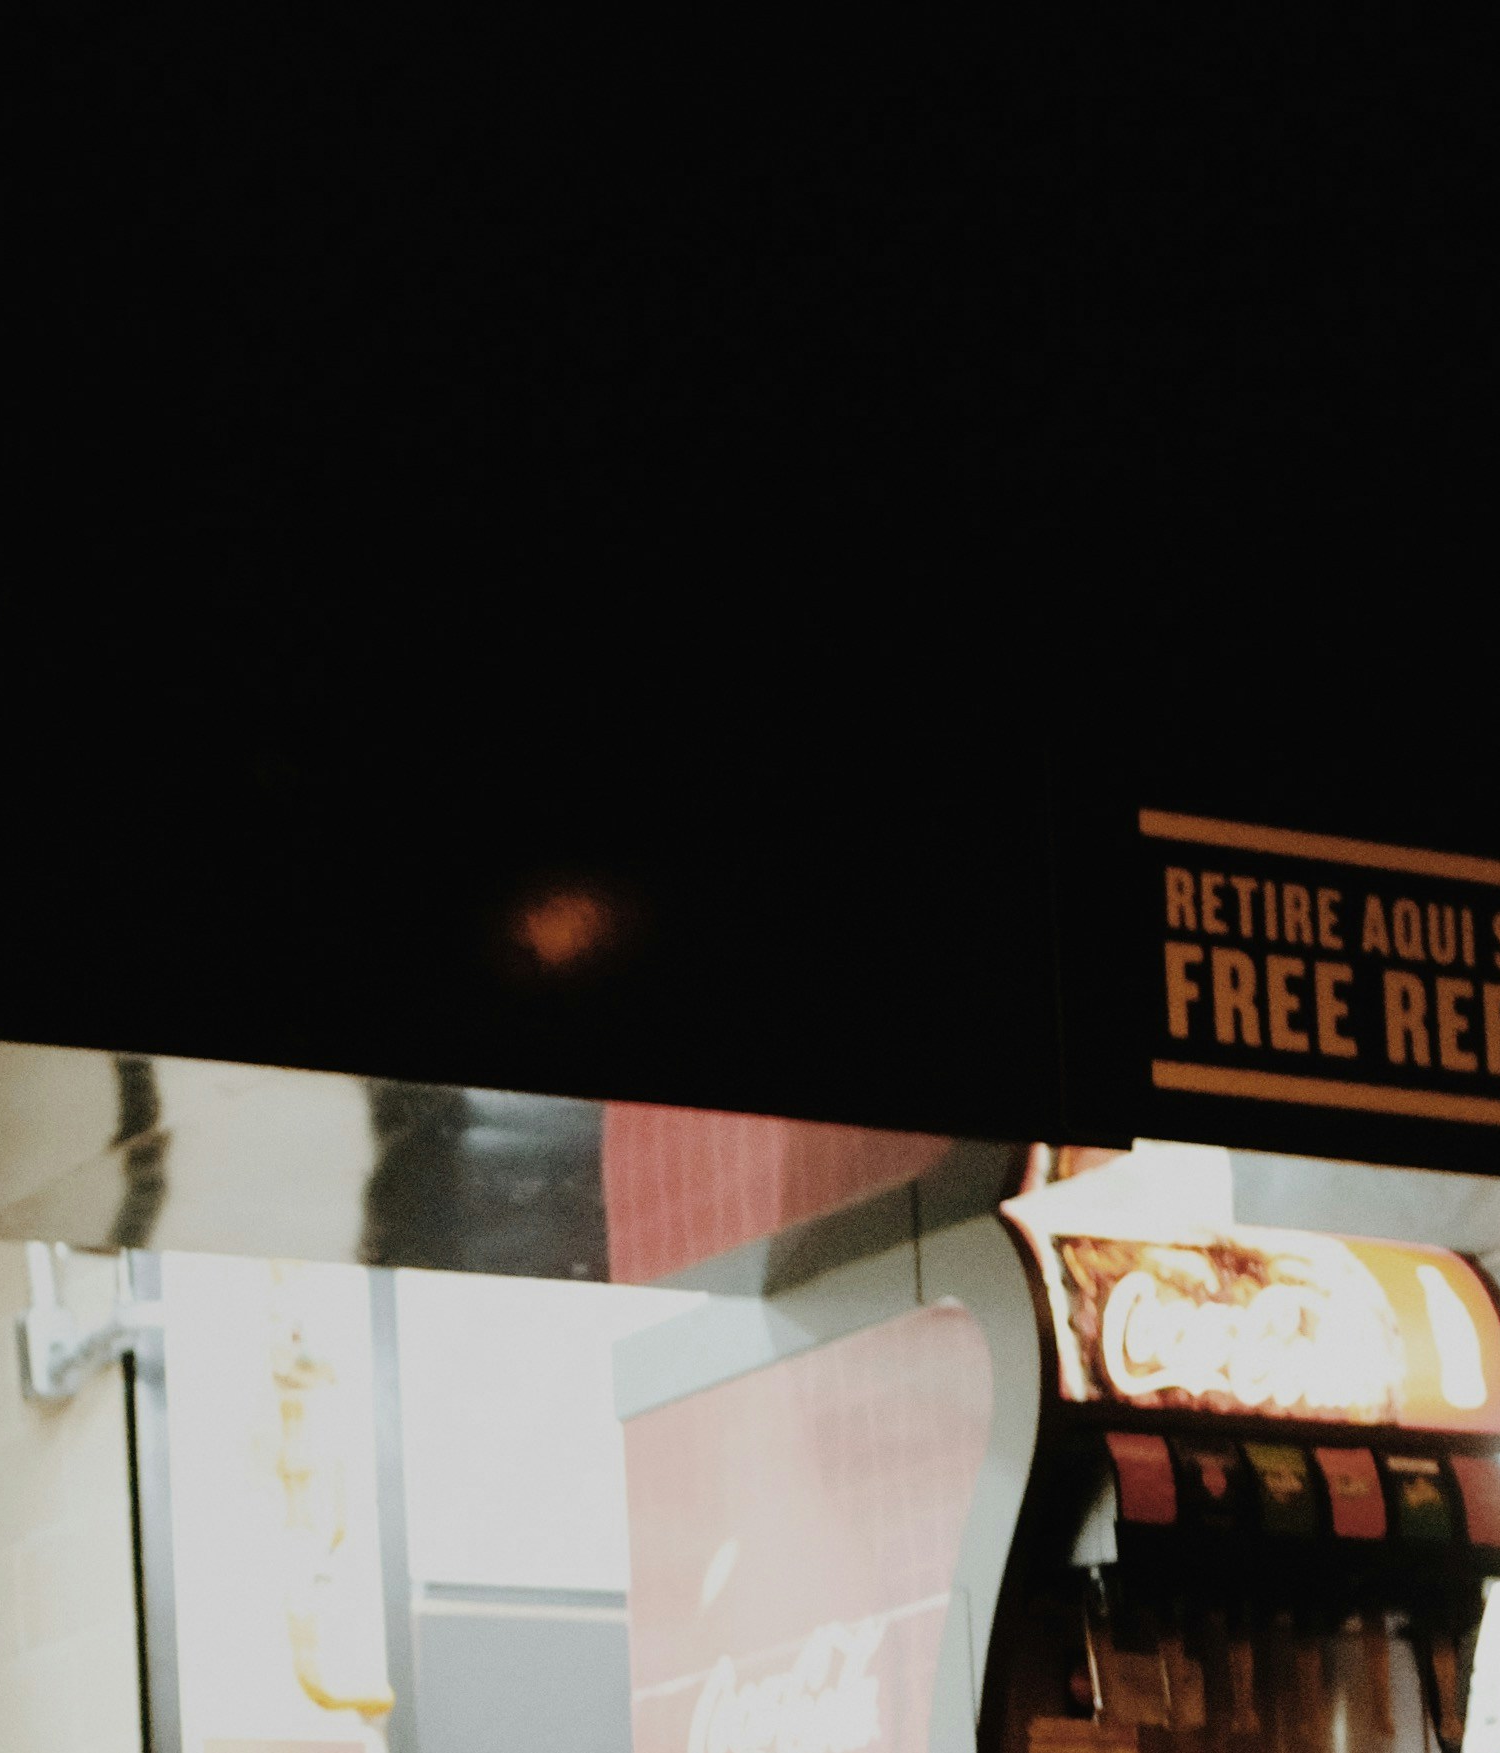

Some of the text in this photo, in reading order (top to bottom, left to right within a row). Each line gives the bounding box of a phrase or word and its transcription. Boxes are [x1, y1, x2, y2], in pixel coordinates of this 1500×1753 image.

[1164, 865, 1345, 951] RETIRE
[1361, 893, 1476, 967] AQUI
[1164, 941, 1359, 1059] FREE
